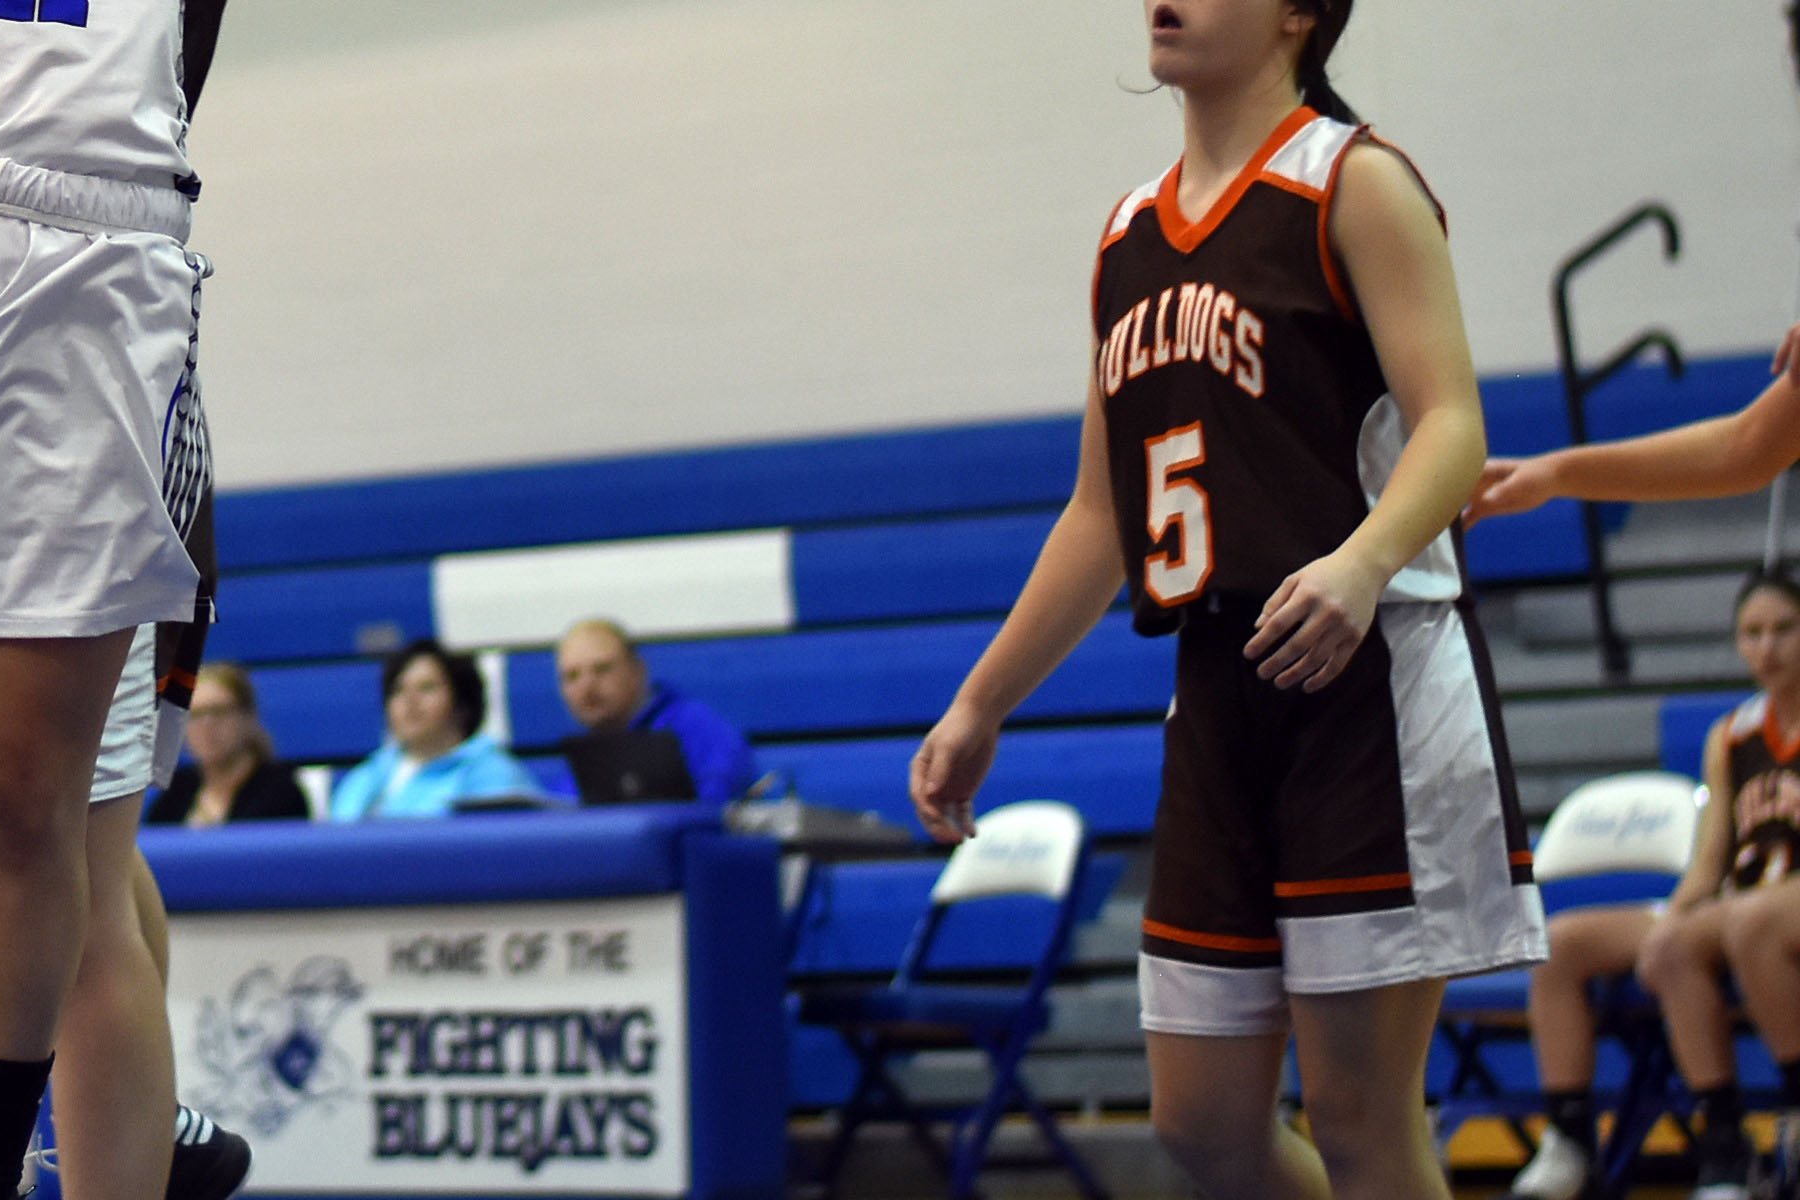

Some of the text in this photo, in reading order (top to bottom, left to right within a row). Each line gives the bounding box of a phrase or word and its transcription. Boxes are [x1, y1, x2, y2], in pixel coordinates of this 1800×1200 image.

[1144, 420, 1214, 608] 5
[387, 929, 631, 976] HOME OF THE
[368, 1006, 658, 1078] FIGHTING
[371, 1090, 659, 1173] BLUEJAYS
